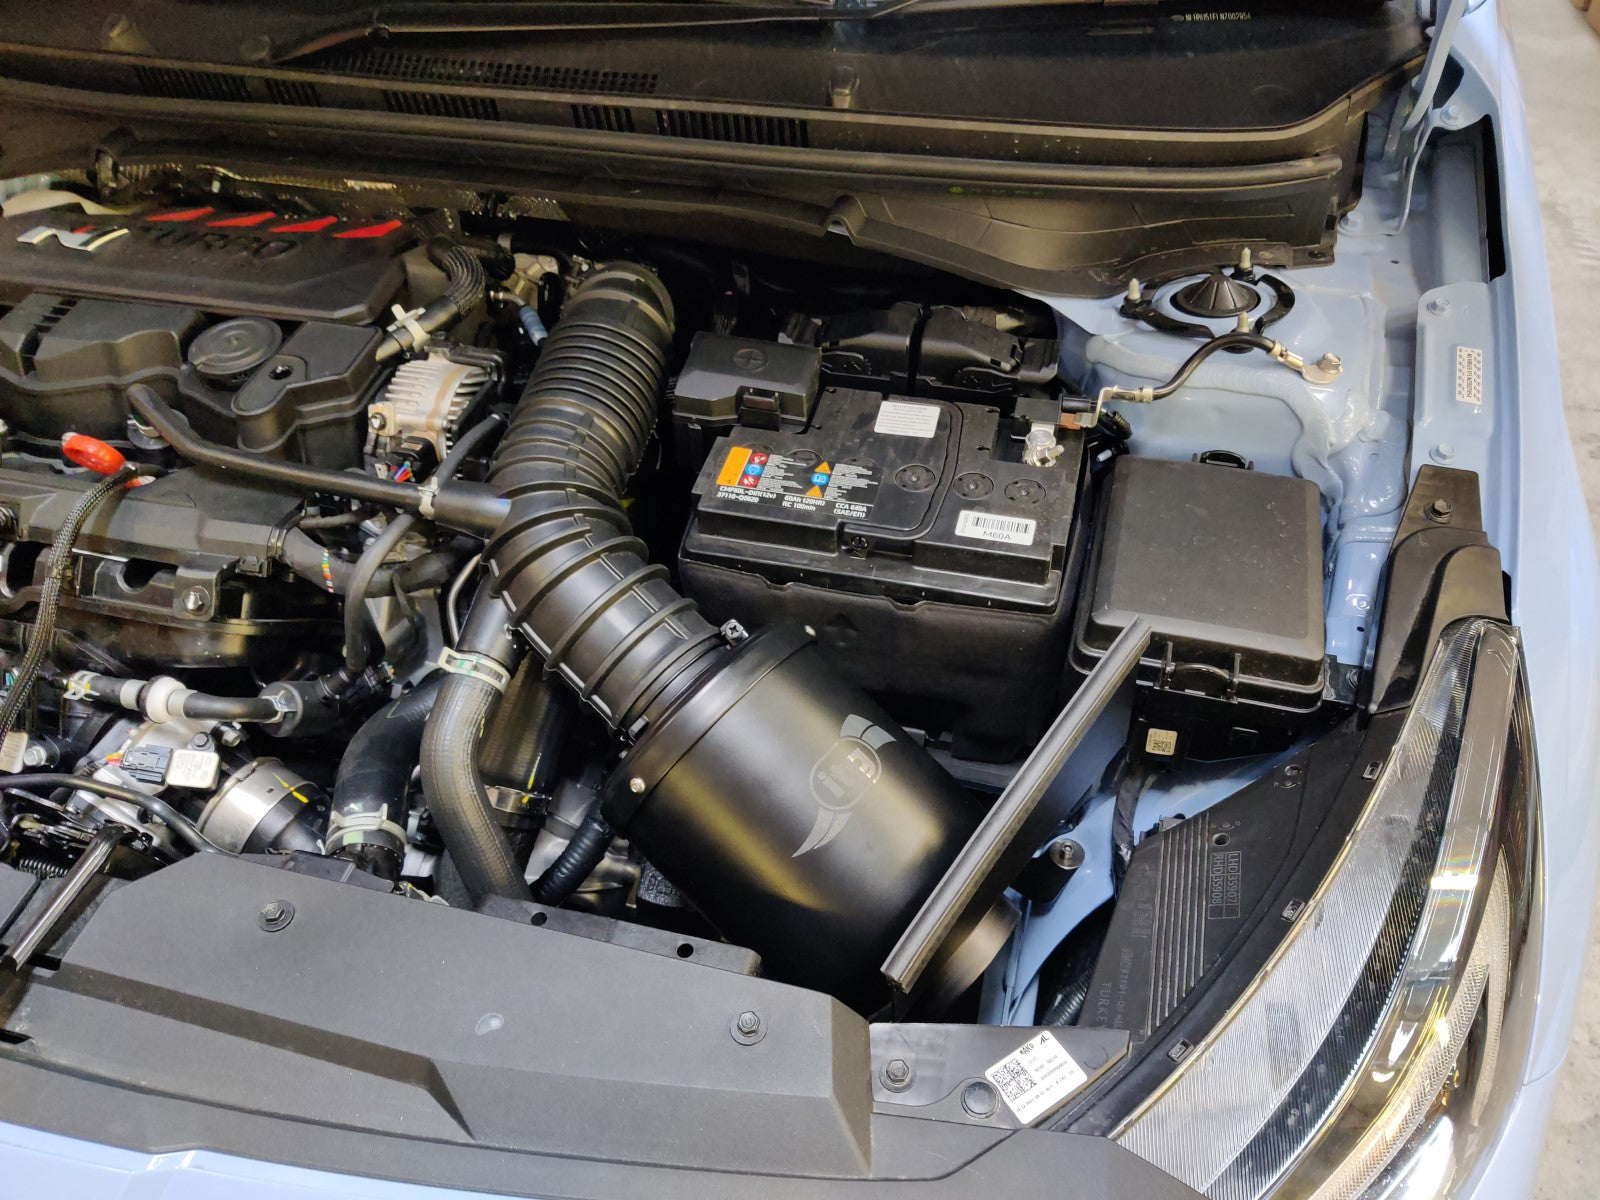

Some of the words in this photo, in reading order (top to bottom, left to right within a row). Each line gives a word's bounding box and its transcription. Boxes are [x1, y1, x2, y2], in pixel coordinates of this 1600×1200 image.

[793, 502, 816, 512] 100min
[835, 502, 849, 510] CCA
[850, 504, 867, 512] 640A
[983, 531, 1011, 541] M60A
[1213, 853, 1224, 874] RHD
[1228, 853, 1239, 872] LHD
[1211, 875, 1224, 905] 35908
[1227, 874, 1238, 903] 35907
